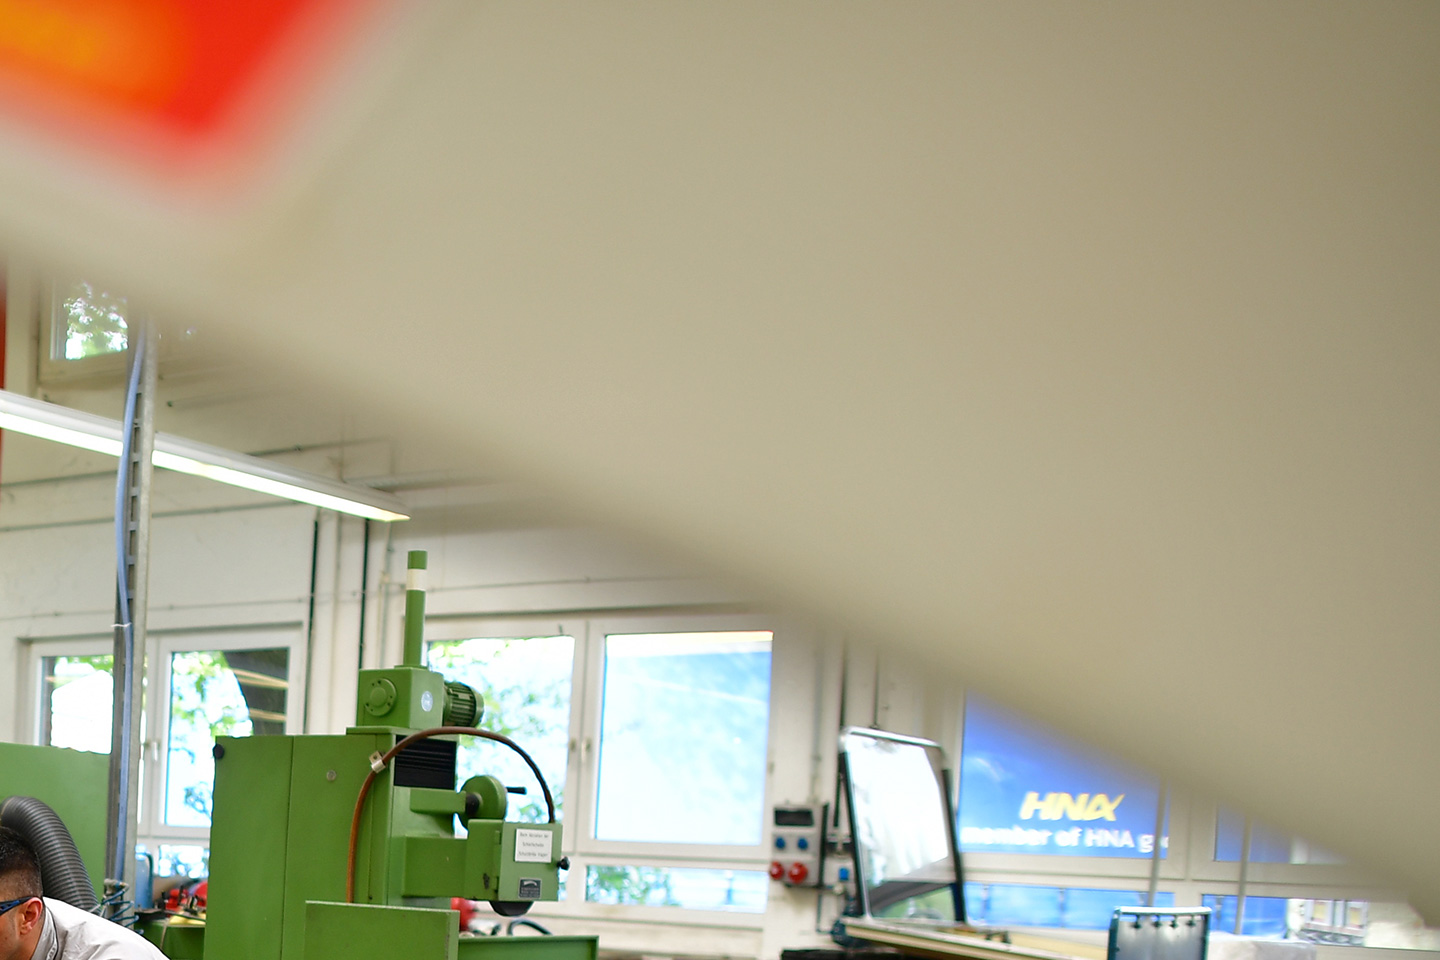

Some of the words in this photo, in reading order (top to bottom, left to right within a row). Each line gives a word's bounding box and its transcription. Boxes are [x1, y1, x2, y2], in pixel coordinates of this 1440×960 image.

[961, 825, 1053, 846] member
[1055, 826, 1082, 847] of
[1085, 829, 1135, 848] HNA
